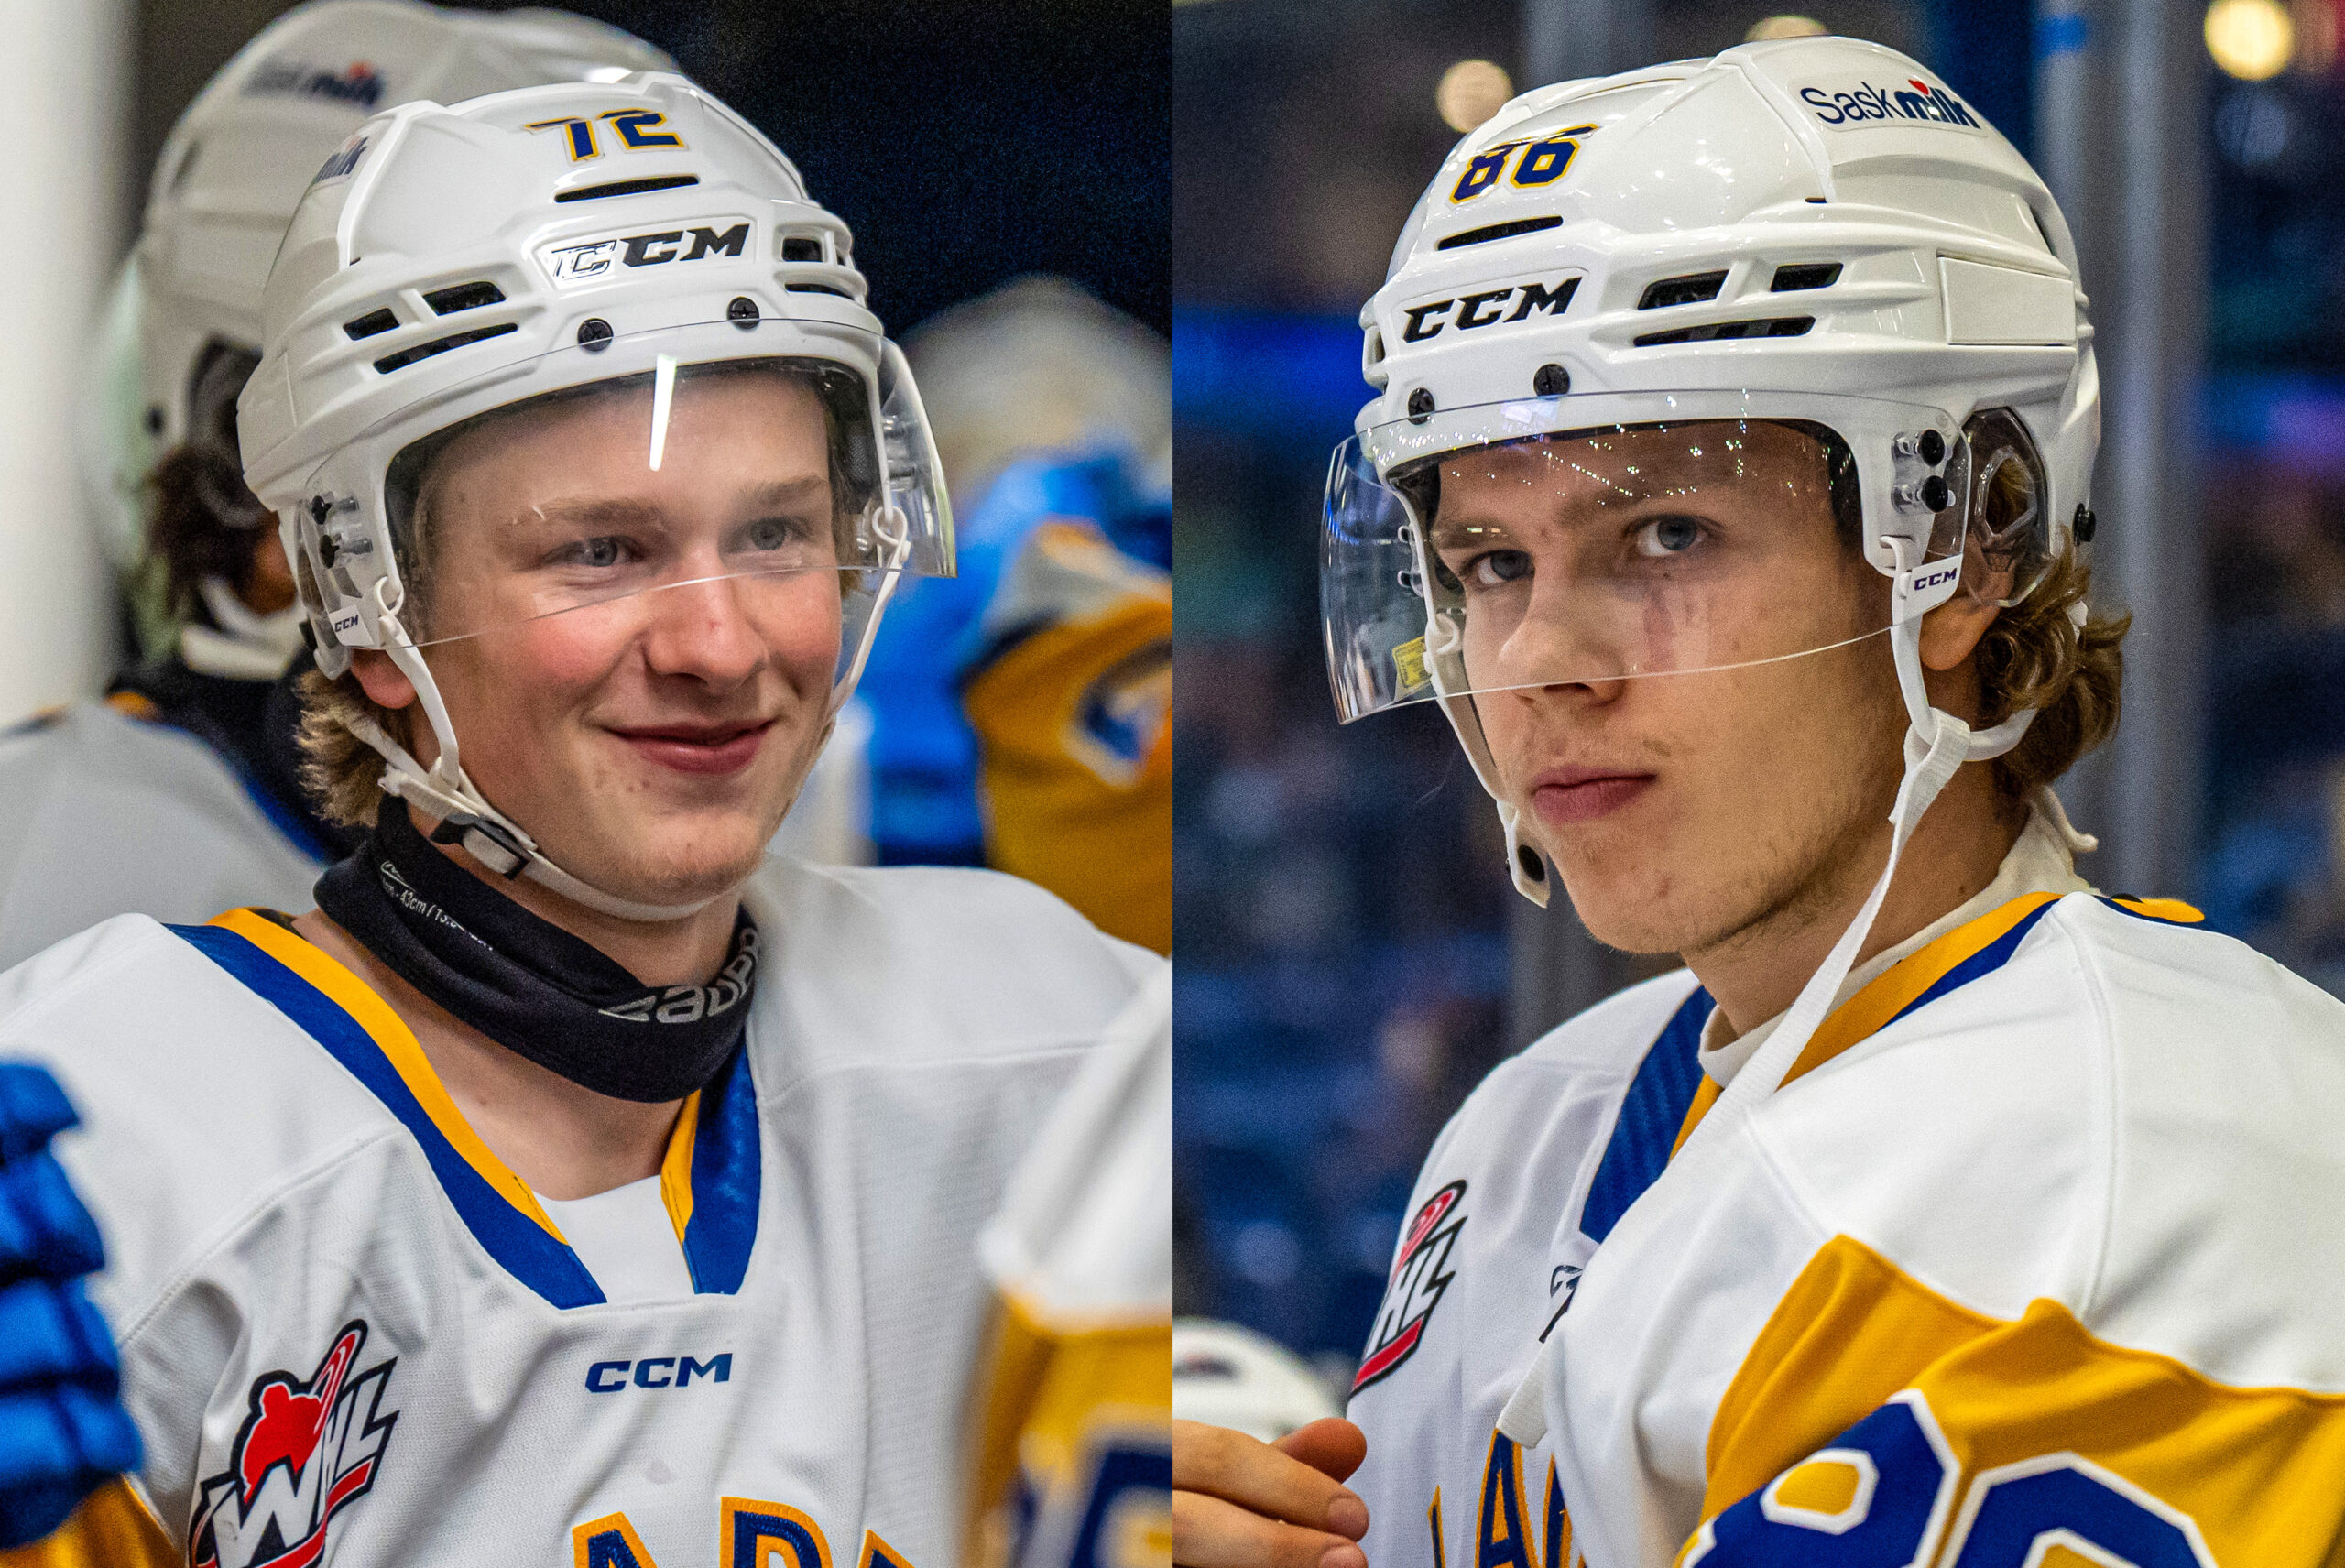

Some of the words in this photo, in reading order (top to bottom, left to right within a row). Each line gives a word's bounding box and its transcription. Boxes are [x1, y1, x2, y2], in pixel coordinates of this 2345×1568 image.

[524, 107, 685, 162] 72
[1449, 123, 1599, 204] 86
[551, 223, 750, 281] CCM
[1402, 277, 1583, 343] CCM
[1914, 567, 1958, 592] CCM
[334, 615, 359, 633] CCM
[584, 1352, 733, 1393] CCM
